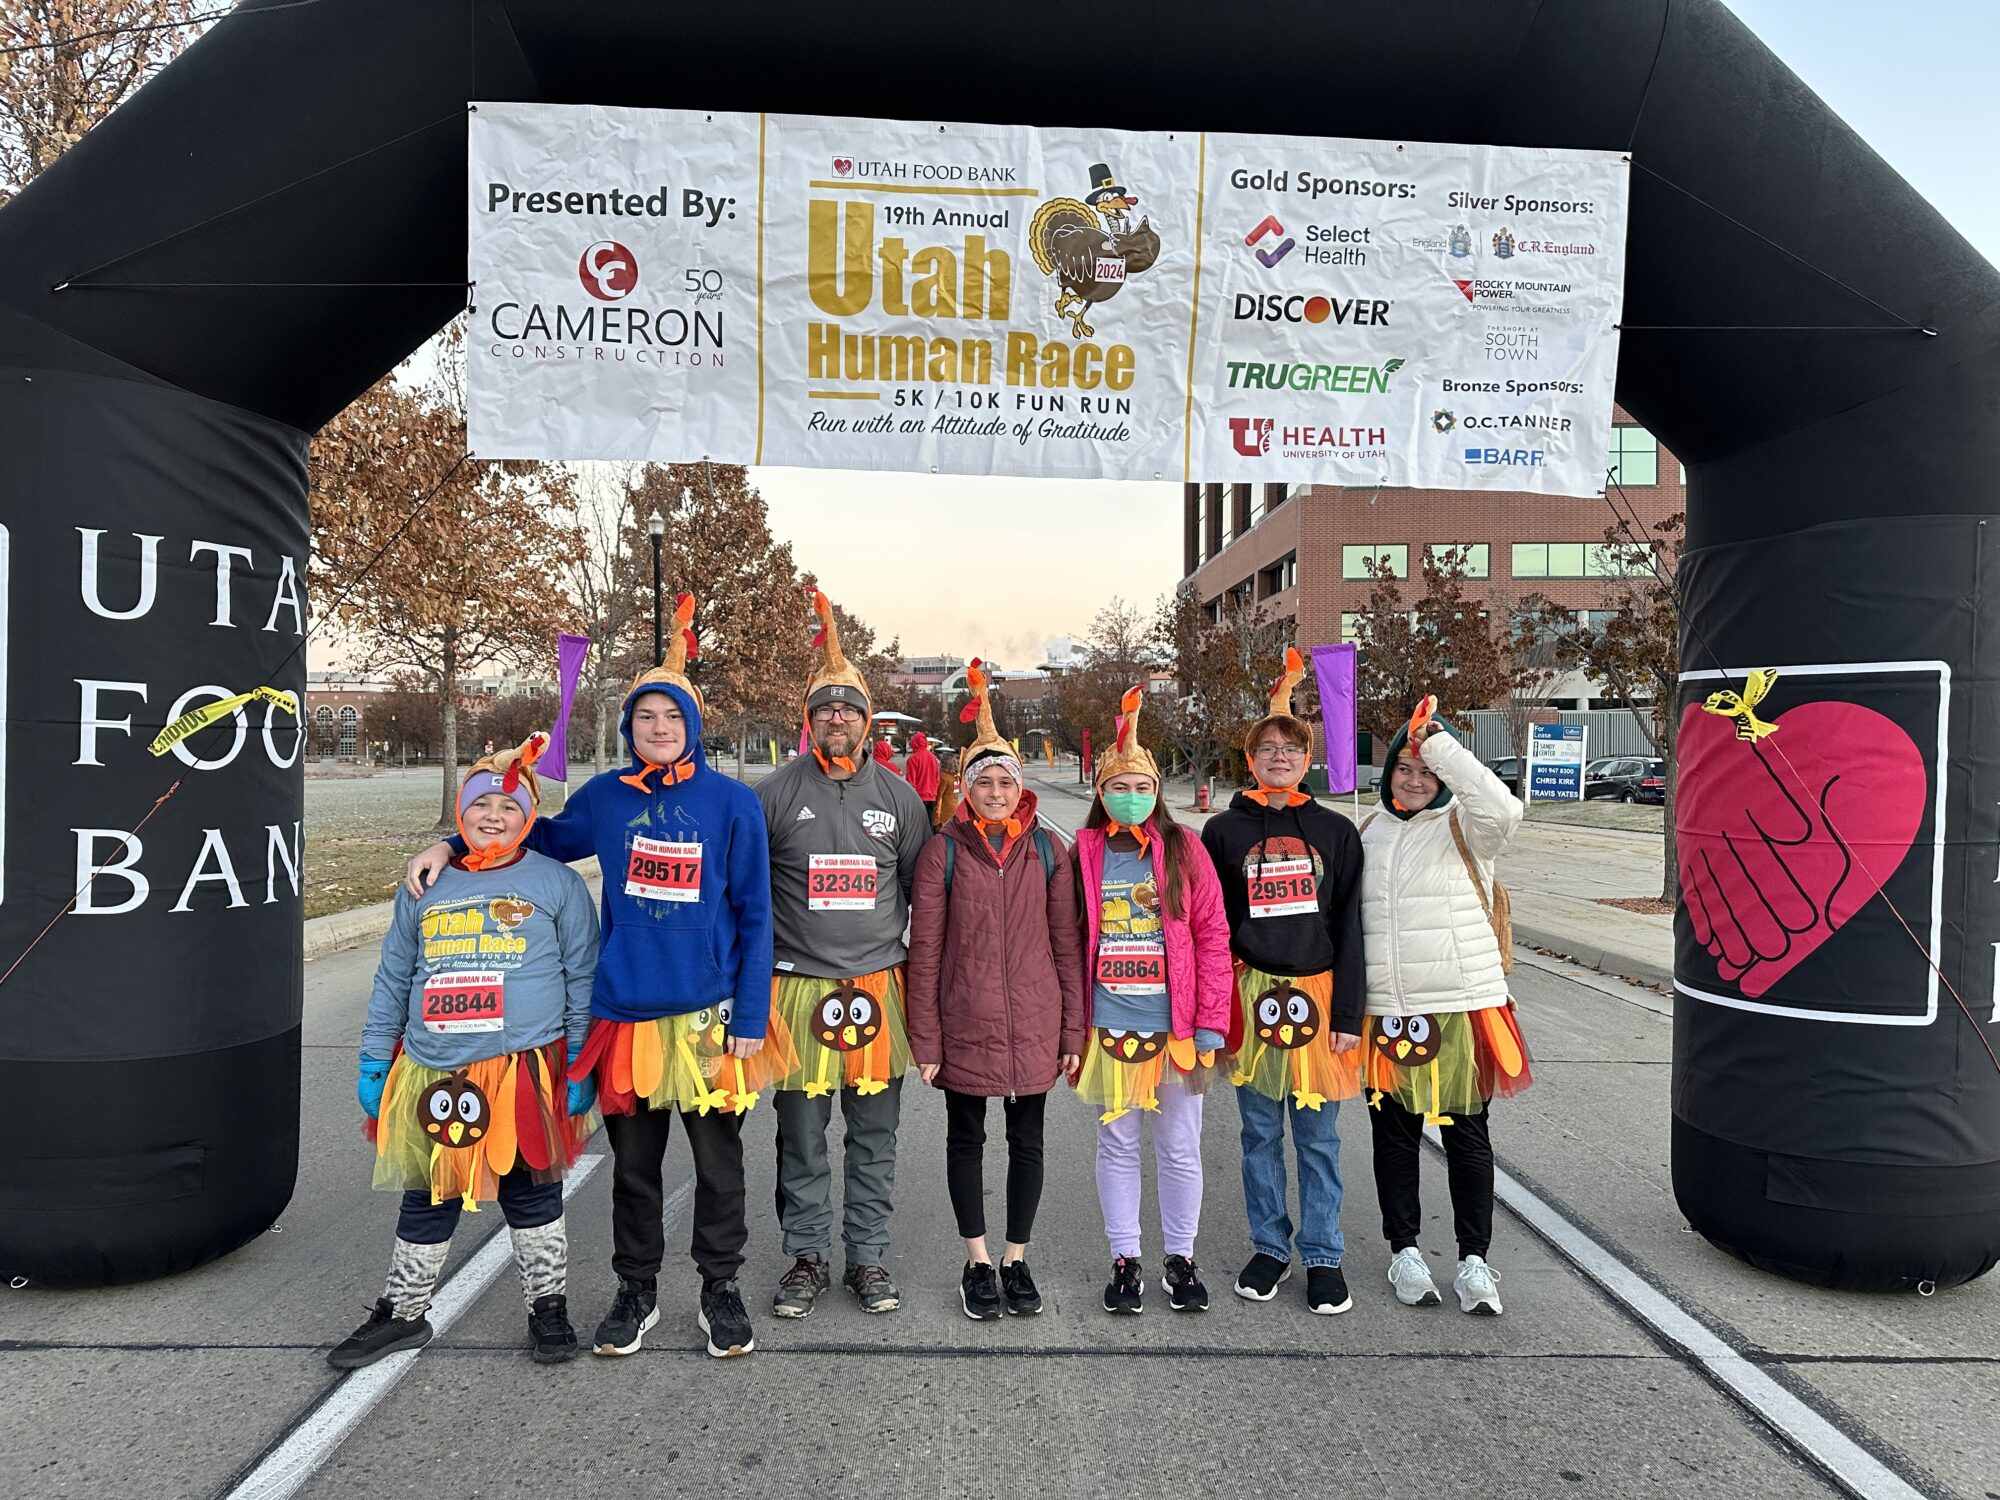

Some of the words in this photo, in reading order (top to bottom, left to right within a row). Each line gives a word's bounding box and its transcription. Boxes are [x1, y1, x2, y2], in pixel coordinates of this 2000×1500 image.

[858, 162, 906, 178] UTAH
[914, 165, 962, 180] FOOD
[968, 167, 1016, 181] BANK
[1231, 169, 1288, 192] Gold
[1297, 172, 1416, 199] Sponsors:
[488, 183, 667, 217] Presented
[682, 188, 736, 227] By:
[1448, 191, 1499, 210] Silver
[1504, 195, 1594, 215] Sponsors:
[884, 206, 925, 225] 19th
[932, 208, 1009, 228] Annual
[1306, 225, 1370, 243] Select
[1413, 238, 1447, 248] England
[808, 199, 1011, 320] Utah
[1305, 246, 1366, 266] Health
[685, 269, 722, 293] 50
[1097, 263, 1123, 279] 2024
[695, 290, 723, 305] years
[1475, 280, 1512, 289] ROCKY
[1515, 282, 1571, 293] MOUNTAIN
[1234, 293, 1389, 326] DISCOVER
[491, 302, 723, 348] CAMERON
[1485, 333, 1538, 347] SOUTH
[491, 343, 724, 367] CONSTRUCTION
[808, 323, 991, 385] Human
[1006, 331, 1135, 390] Race
[1485, 348, 1538, 360] TOWN
[1226, 361, 1390, 393] TRUGREEN
[1442, 379, 1500, 393] Bronze
[1505, 379, 1584, 396] Sponsors:
[894, 389, 924, 406] 5K
[935, 389, 943, 409] /
[956, 391, 1000, 409] 10K
[1016, 393, 1064, 411] FUN
[1081, 397, 1130, 414] RUN
[808, 411, 847, 433] Run
[852, 412, 894, 434] with
[900, 417, 925, 434] an
[932, 414, 1007, 436] Attitude
[1012, 417, 1032, 446] of
[1038, 418, 1130, 442] Gratitude
[1283, 426, 1385, 446] HEALTH
[1283, 449, 1339, 459] UNIVERSITY
[1342, 451, 1355, 459] OF
[1358, 450, 1385, 459] UTAH
[75, 526, 304, 635] UTA
[71, 678, 304, 770] FOO
[1531, 789, 1555, 797] TRAVIS
[1557, 790, 1578, 798] YATES
[644, 843, 657, 852] UTAH
[659, 845, 681, 854] HUMAN
[683, 847, 698, 855] RACE
[68, 821, 301, 915] BAN
[632, 857, 698, 883] 29517
[1275, 865, 1295, 873] HUMAN
[1296, 863, 1309, 871] RACE
[813, 874, 875, 892] 32346
[1252, 878, 1313, 900] 29518
[1102, 897, 1131, 920] ah
[422, 909, 484, 938] Utah
[479, 934, 526, 953] Race
[480, 961, 487, 971] of
[489, 961, 522, 969] Gratitude
[1101, 960, 1160, 978] 28864
[440, 976, 454, 985] UTAH
[456, 976, 480, 984] HUMAN
[427, 992, 497, 1015] 28844
